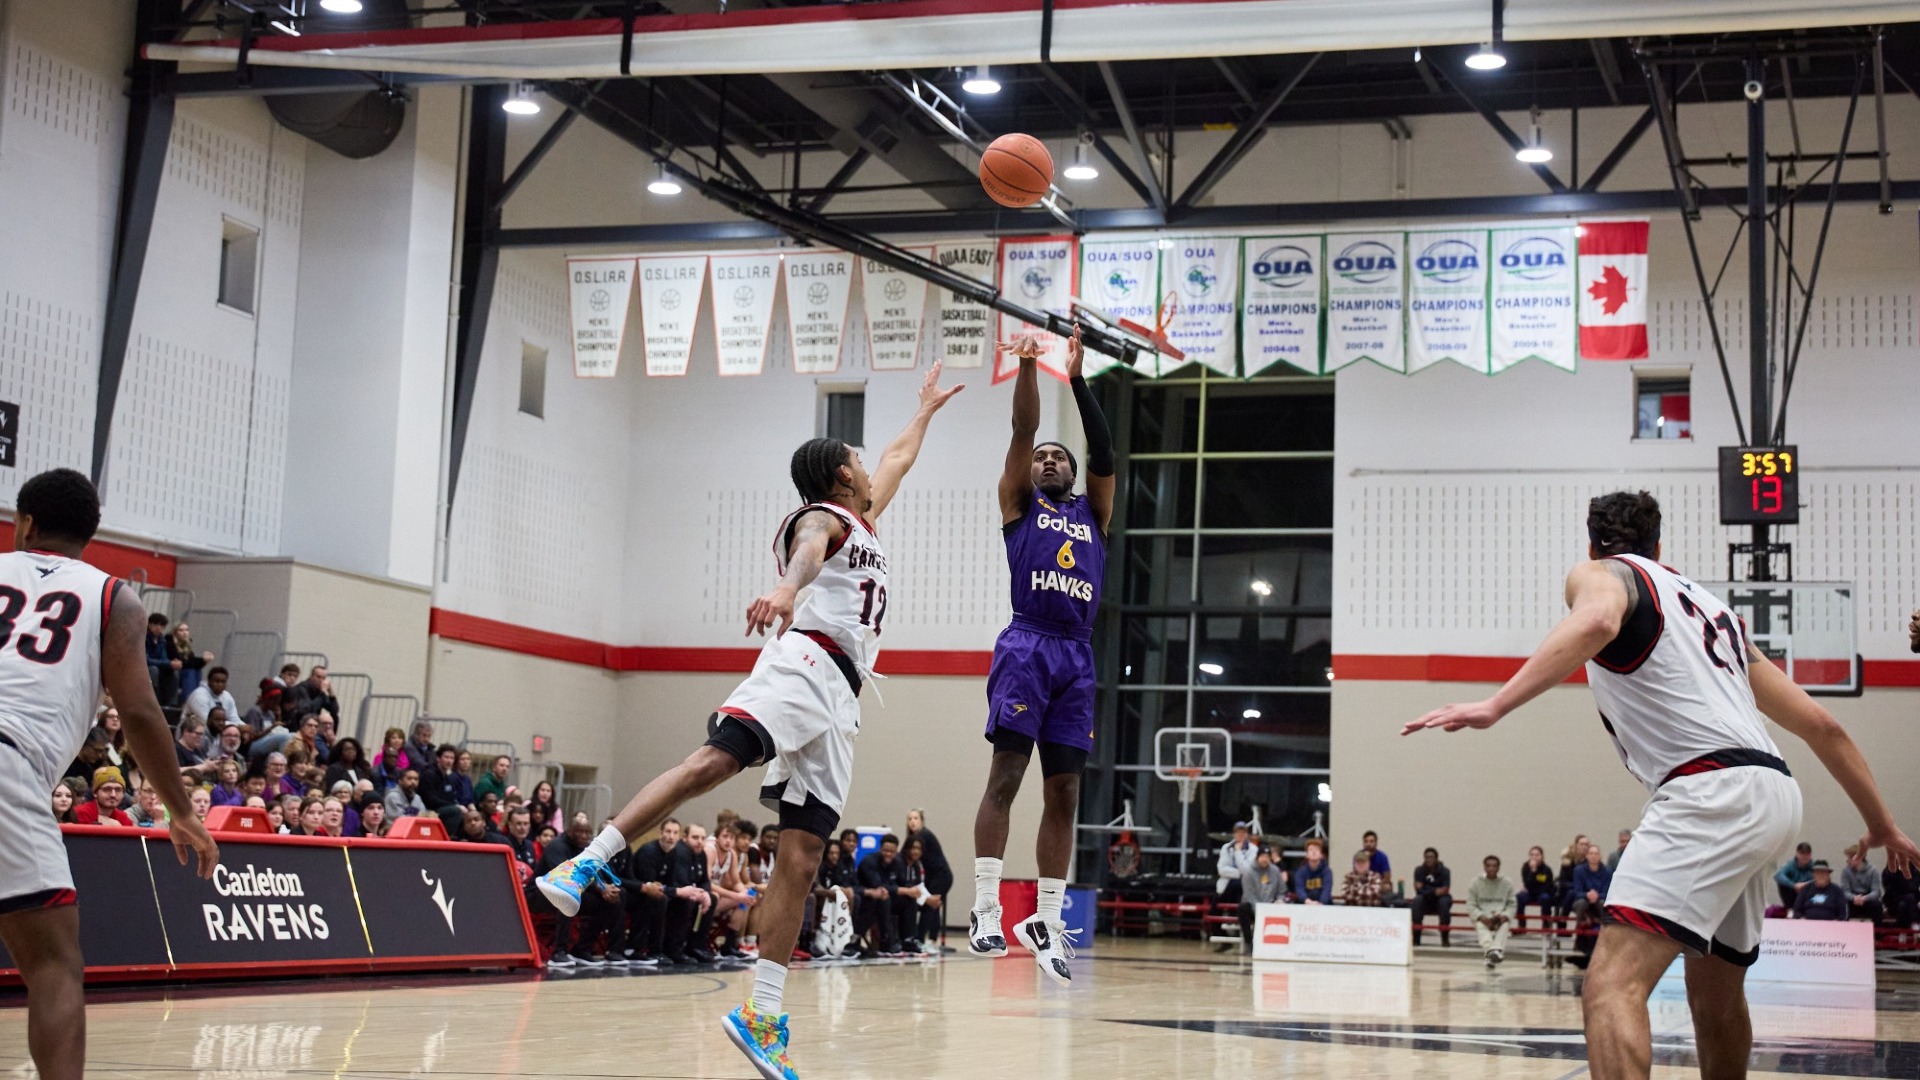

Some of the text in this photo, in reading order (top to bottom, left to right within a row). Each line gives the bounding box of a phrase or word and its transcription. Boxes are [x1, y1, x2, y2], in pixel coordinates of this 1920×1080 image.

[969, 248, 994, 267] EAST
[1185, 248, 1216, 258] OUA
[1501, 253, 1566, 267] OUA
[1253, 261, 1313, 275] OUA
[1334, 256, 1397, 271] OUA
[1416, 255, 1479, 270] OUA
[1247, 303, 1317, 315] CHAMPIONS
[1330, 299, 1402, 311] CHAMPIONS
[1412, 299, 1484, 311] CHAMPIONS
[1495, 297, 1571, 308] CHAMPIONS
[941, 309, 987, 321] BASKETBALL
[872, 332, 916, 343] CHAMPIONS
[942, 326, 985, 338] CHAMPIONS
[1171, 330, 1223, 338] Basketball
[1743, 452, 1792, 476] 3:57
[1752, 476, 1783, 513] 13
[1037, 513, 1093, 544] GOLDEN
[1056, 539, 1076, 569] 6
[1031, 570, 1094, 602] HAWKS
[213, 863, 305, 897] Carleton
[202, 903, 330, 942] RAVENS
[1297, 923, 1400, 938] THE BOOKSTORE
[1760, 938, 1847, 950] rleton university
[1799, 950, 1858, 959] association
